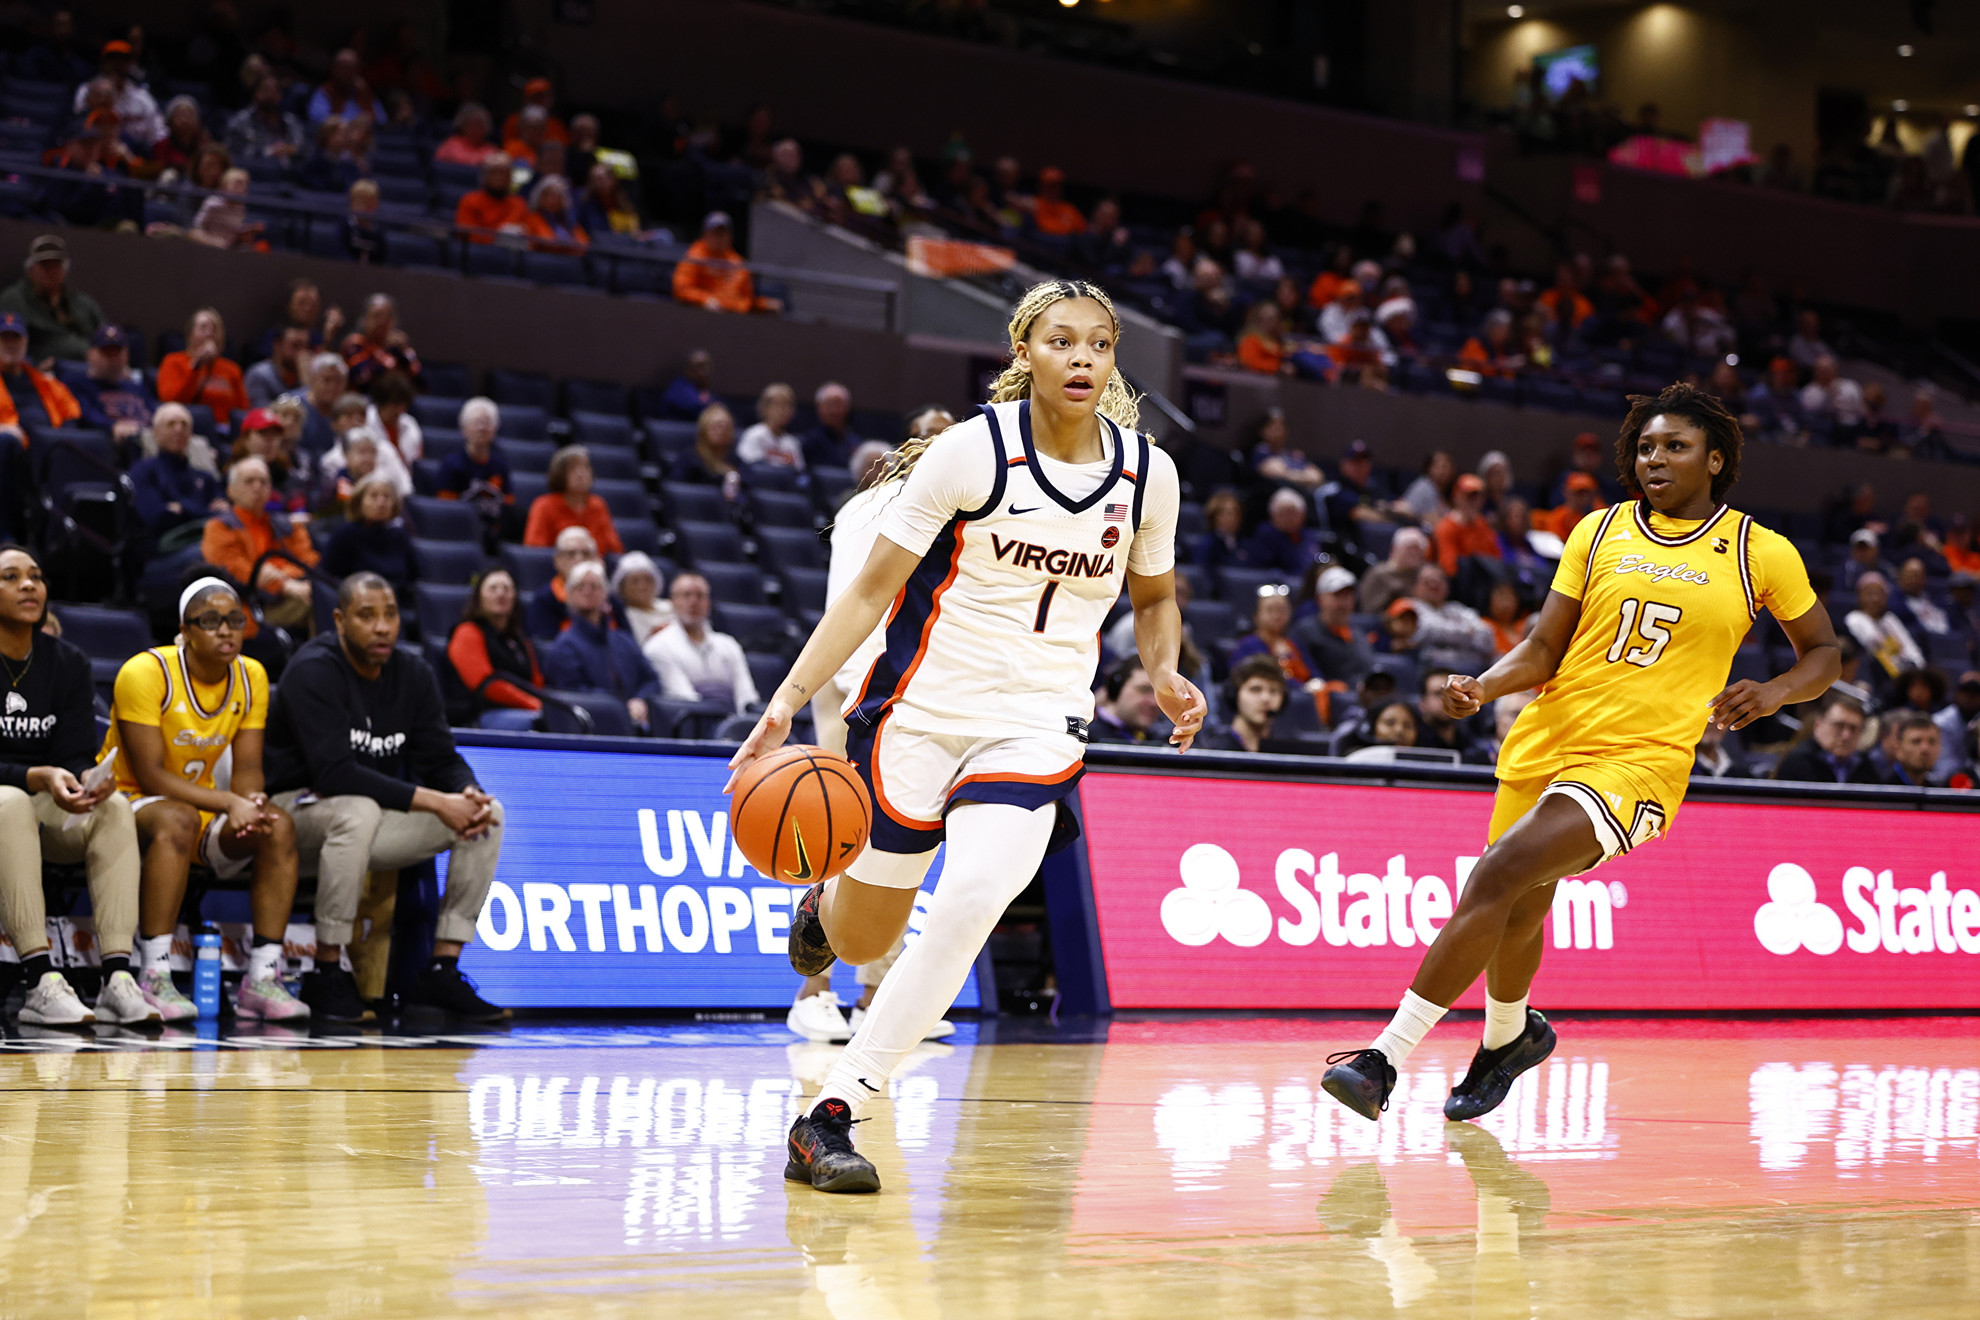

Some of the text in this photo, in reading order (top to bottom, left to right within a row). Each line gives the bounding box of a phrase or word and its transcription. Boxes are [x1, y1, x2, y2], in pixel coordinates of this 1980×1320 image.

[990, 532, 1114, 579] VIRGINIA
[1614, 554, 1710, 585] Eagles
[1033, 579, 1061, 634] 1
[1605, 597, 1683, 668] 15
